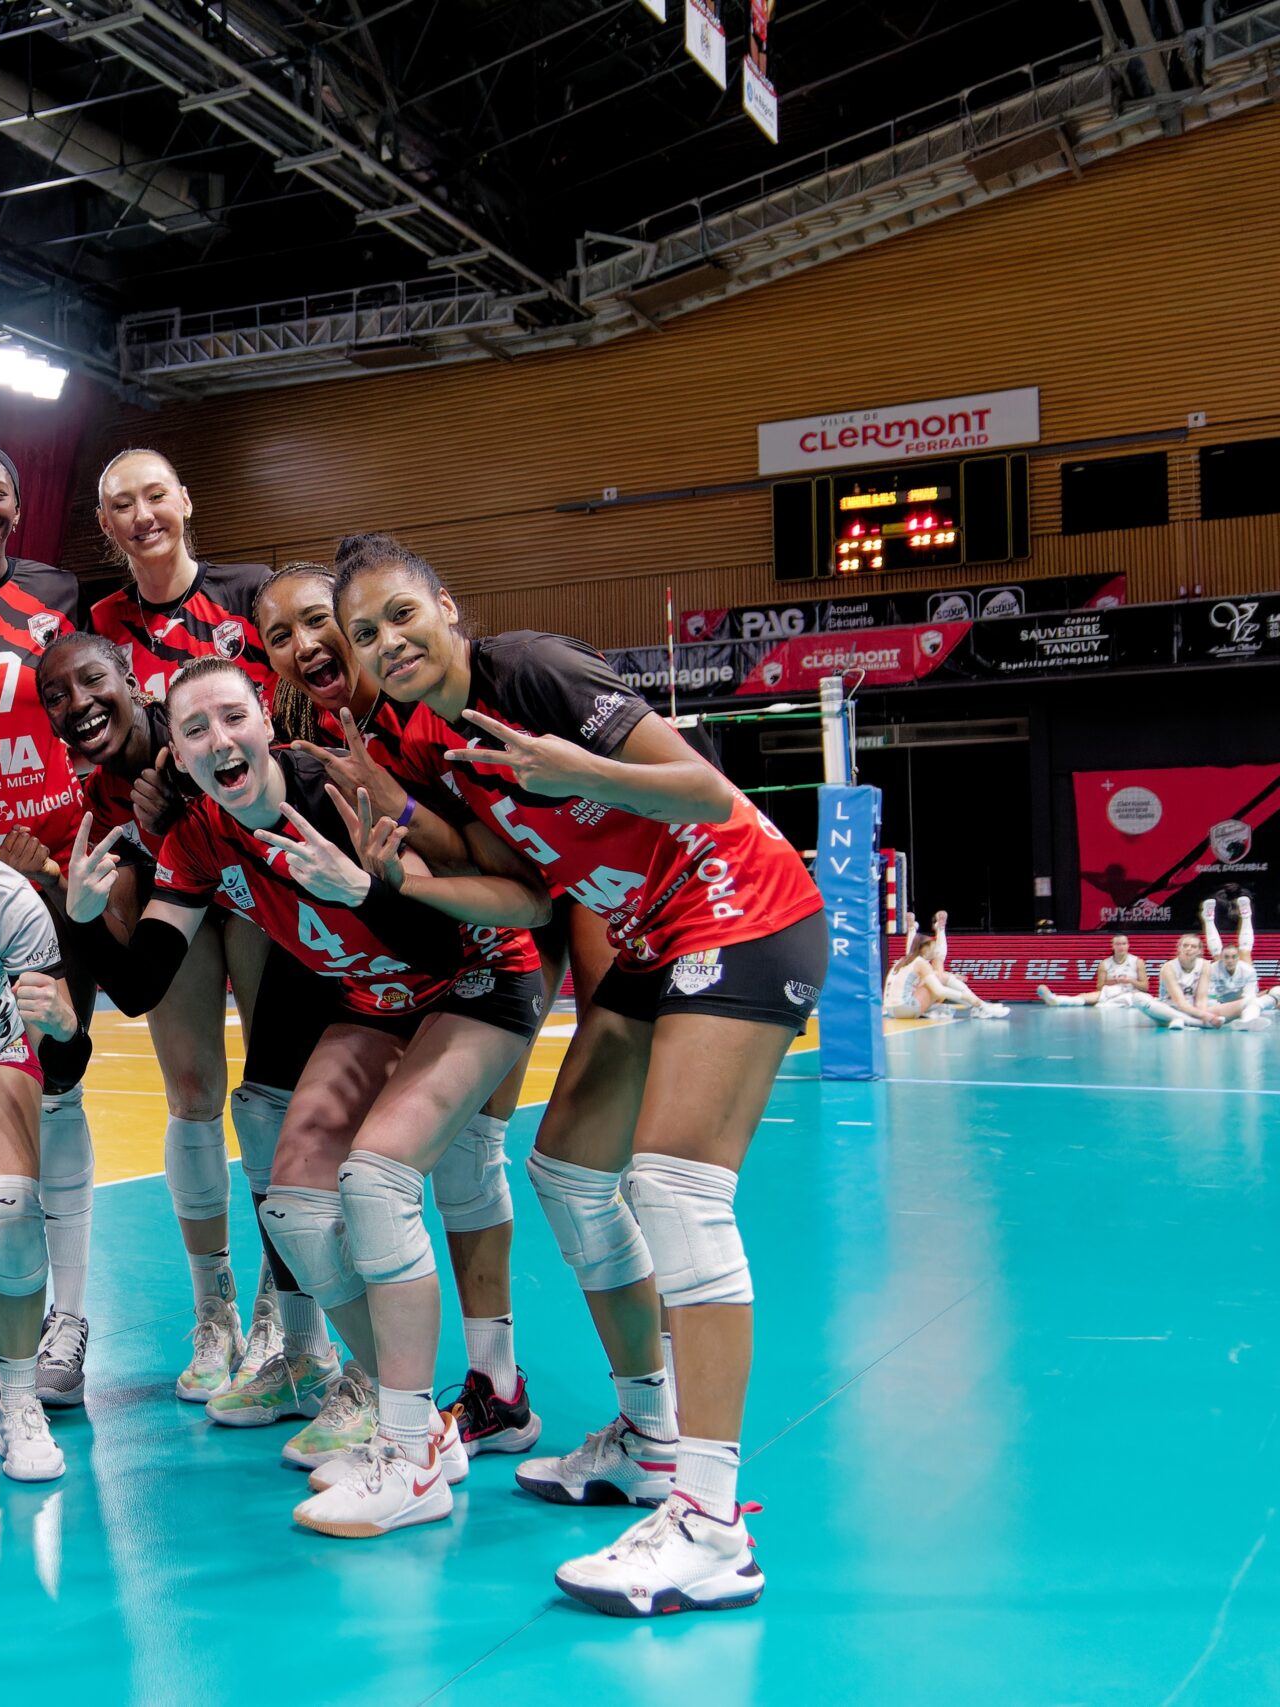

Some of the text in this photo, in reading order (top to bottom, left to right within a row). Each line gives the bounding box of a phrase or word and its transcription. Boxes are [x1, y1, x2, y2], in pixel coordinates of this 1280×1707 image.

[821, 412, 879, 426] VILLE DE
[829, 602, 868, 615] Accueil
[742, 608, 805, 639] PAG
[1020, 624, 1101, 641] SAUVESTRE
[621, 664, 734, 690] montagne
[7, 772, 46, 789] MICHY
[16, 785, 74, 820] Mutuel
[570, 798, 593, 817] cler
[576, 801, 600, 825] auve
[490, 795, 561, 865] 5
[565, 865, 647, 914] HA
[297, 900, 346, 959] 4
[674, 964, 719, 977] SPORT
[1026, 959, 1076, 980] BE
